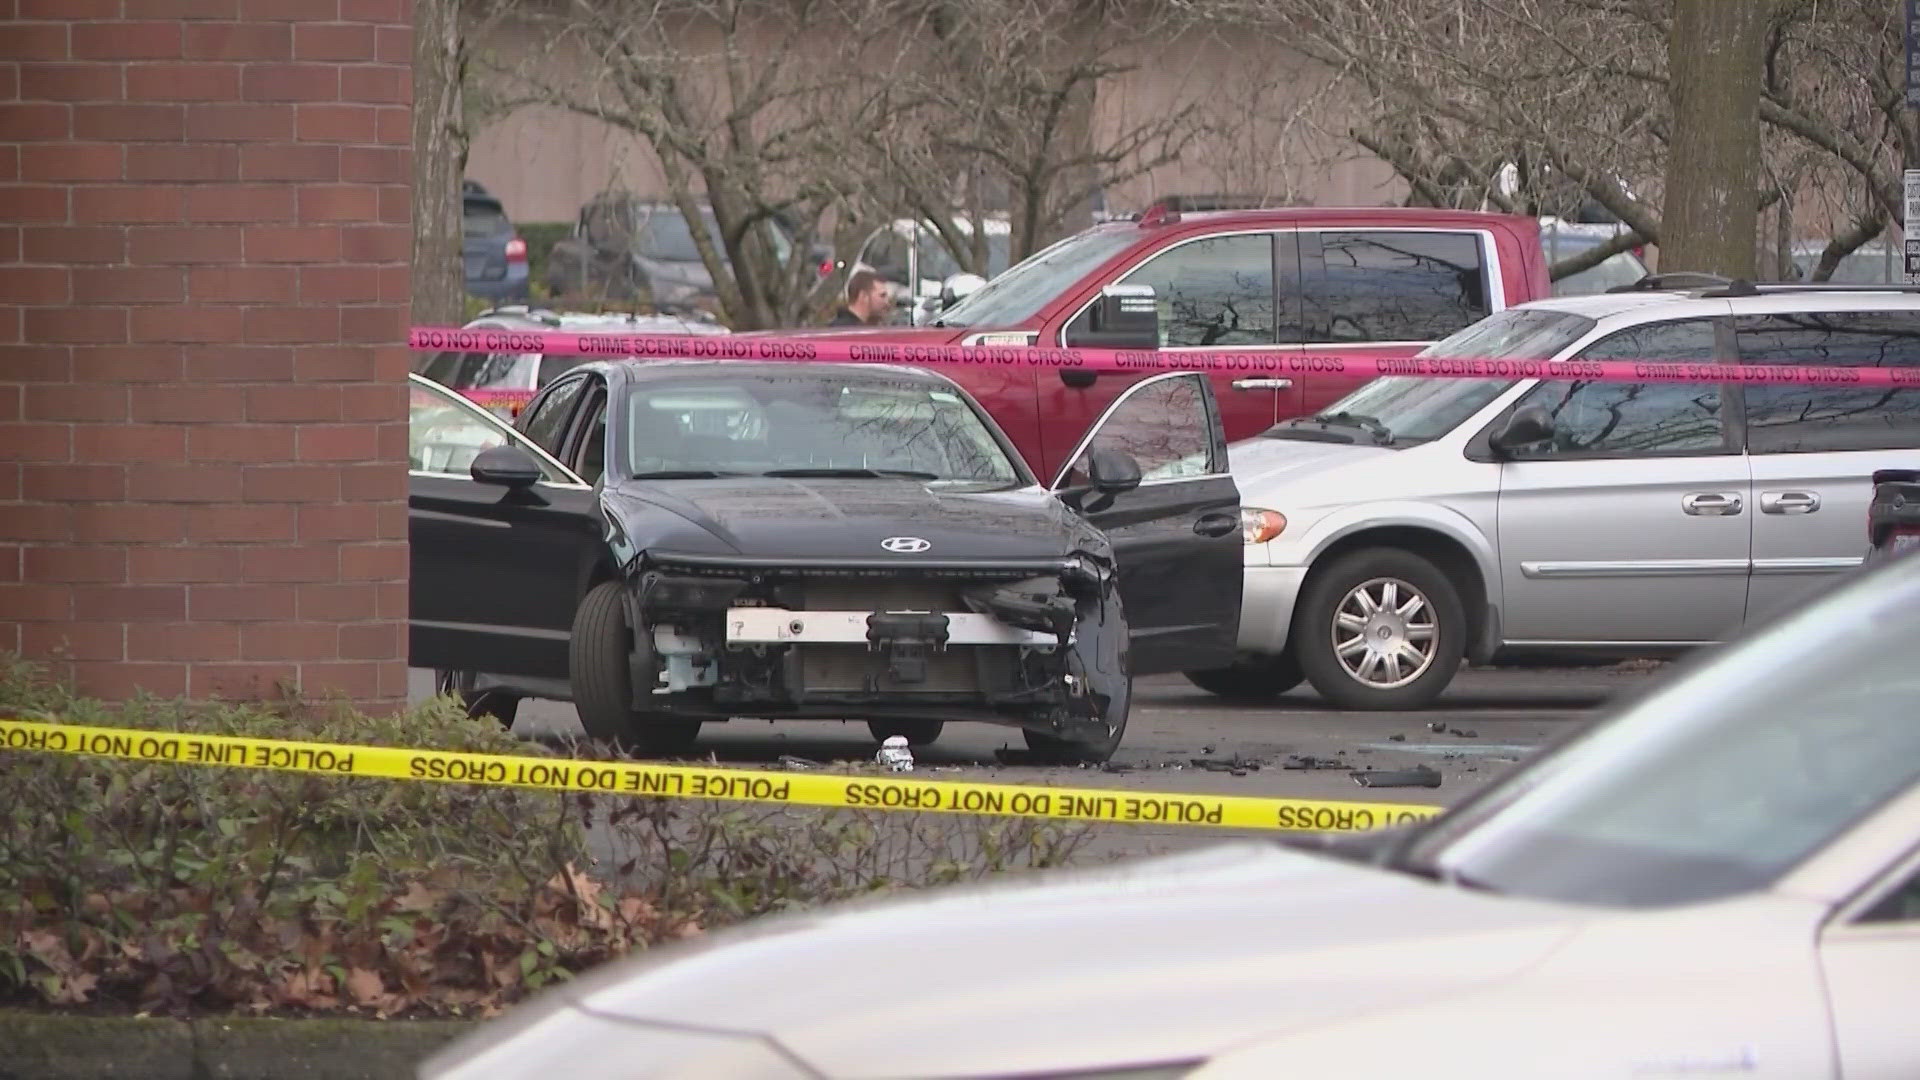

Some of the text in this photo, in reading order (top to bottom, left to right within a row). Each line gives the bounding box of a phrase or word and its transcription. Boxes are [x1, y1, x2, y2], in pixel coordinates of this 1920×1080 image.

[419, 332, 443, 348] DO
[447, 333, 480, 350] NOT
[486, 334, 545, 351] CROSS
[578, 337, 816, 360] CRIME SCENE DO NOT CROSS
[850, 345, 1083, 366] CRIME SCENE DO NOT CROSS
[1115, 352, 1345, 372] CRIME SCENE DO NOT CROSS
[1376, 358, 1604, 378] CRIME SCENE DO NOT CROSS
[1635, 364, 1860, 382] CRIME SCENE DO NOT CROSS
[78, 733, 131, 755] NOT
[138, 737, 180, 758] DO
[187, 743, 247, 764] LINE
[255, 747, 354, 772] POLICE
[410, 757, 789, 800] POLICE LINE DO NOT CROSS
[845, 784, 1222, 824] POLICE LINE DO NOT CROSS
[1279, 806, 1373, 830] CROSS
